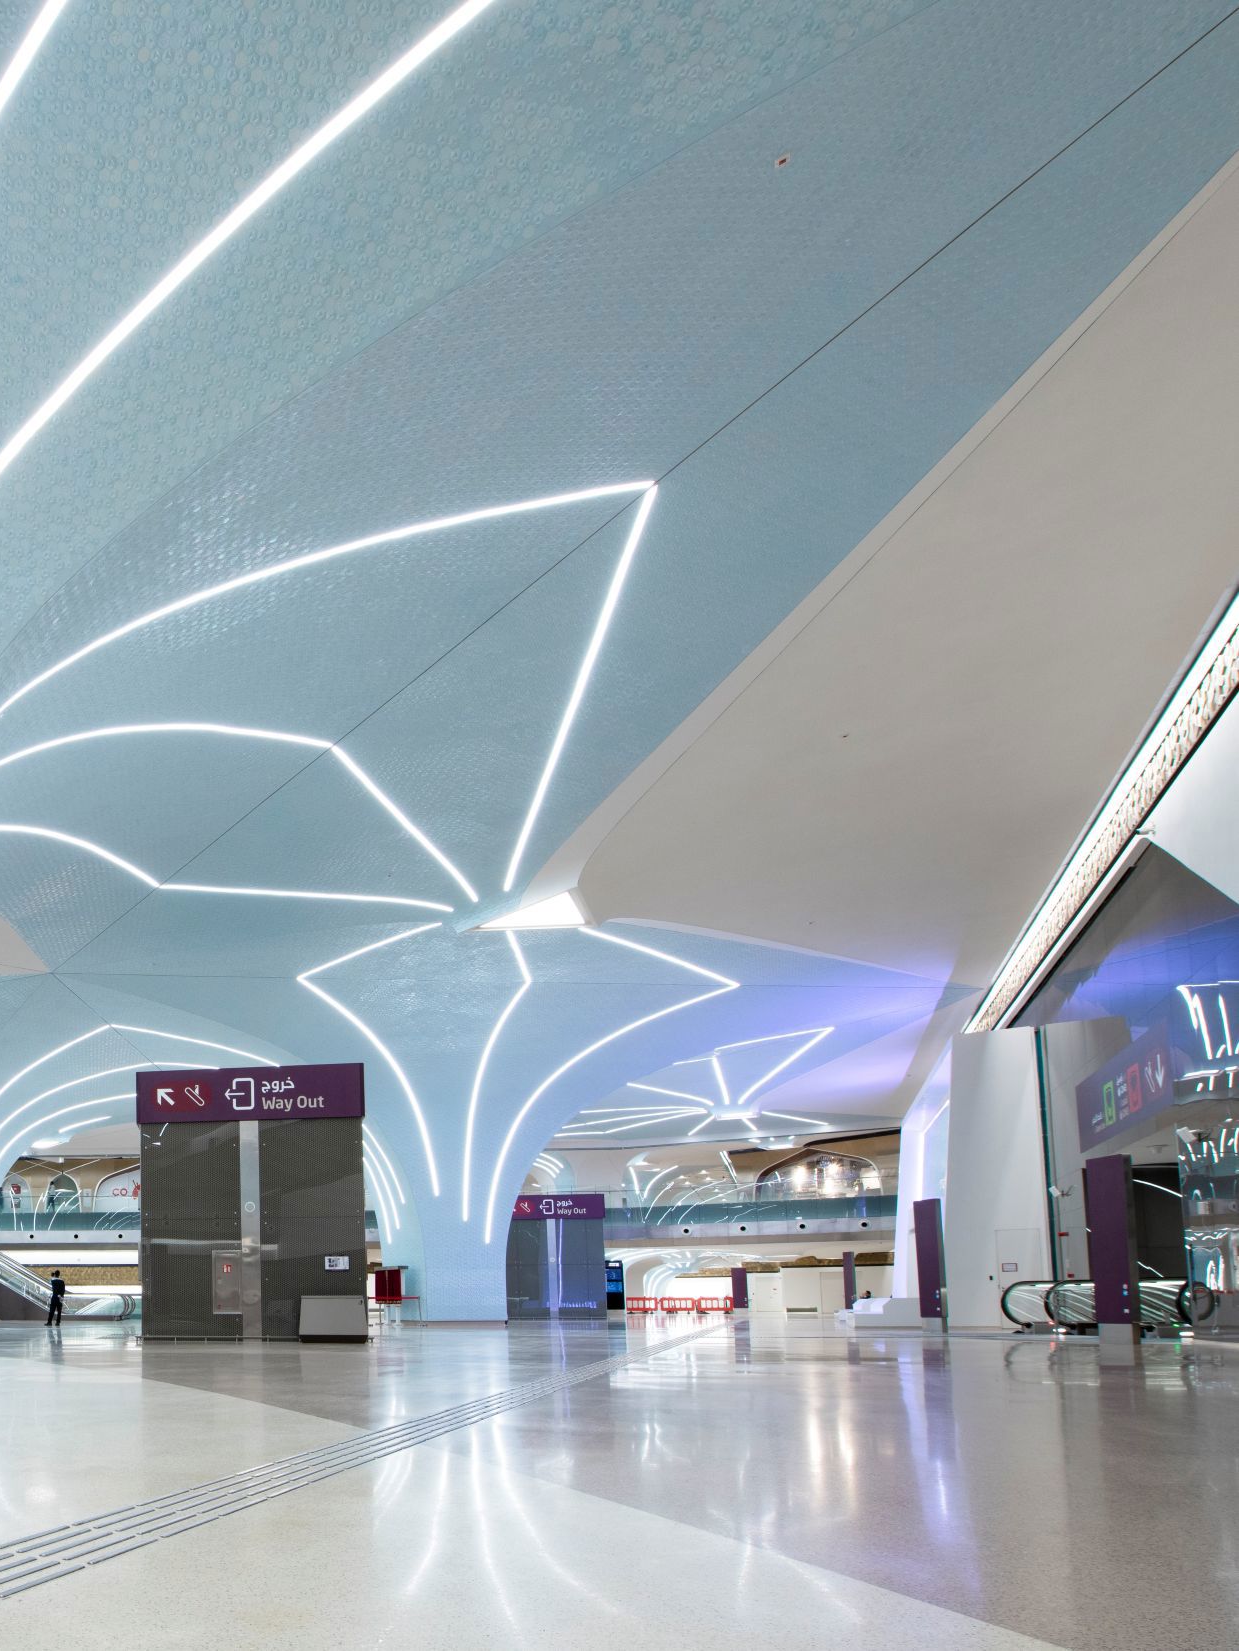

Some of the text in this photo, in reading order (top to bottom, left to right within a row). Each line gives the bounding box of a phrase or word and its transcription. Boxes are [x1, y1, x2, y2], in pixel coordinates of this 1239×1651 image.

[261, 1076, 295, 1093] خروج
[262, 1095, 325, 1112] Way Out
[556, 1199, 573, 1207] خروج
